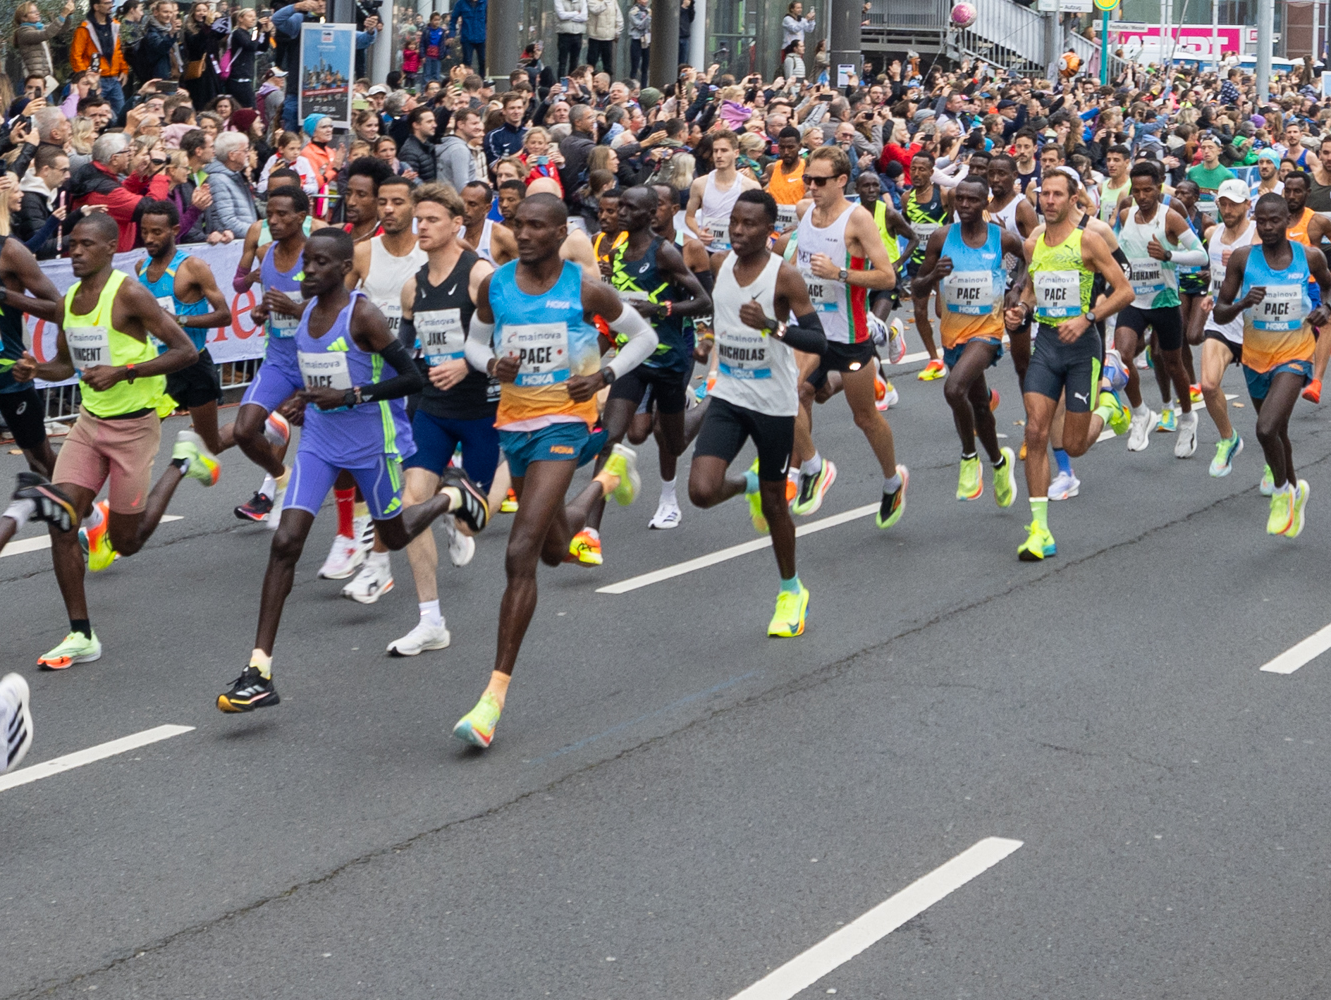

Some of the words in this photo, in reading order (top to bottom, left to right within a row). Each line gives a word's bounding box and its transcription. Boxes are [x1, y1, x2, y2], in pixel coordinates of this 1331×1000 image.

[957, 276, 988, 284] mainova
[1045, 276, 1075, 284] mainova
[956, 287, 981, 300] PACE
[1044, 287, 1067, 301] PACE
[958, 306, 980, 314] HOKA
[1264, 302, 1290, 315] PACE
[1265, 322, 1289, 330] HOKA
[427, 332, 447, 346] JAKE
[518, 331, 562, 342] mainova
[727, 334, 763, 344] mainova
[520, 347, 552, 364] PACE
[719, 344, 765, 361] NICHOLAS
[522, 374, 554, 385] HOKA
